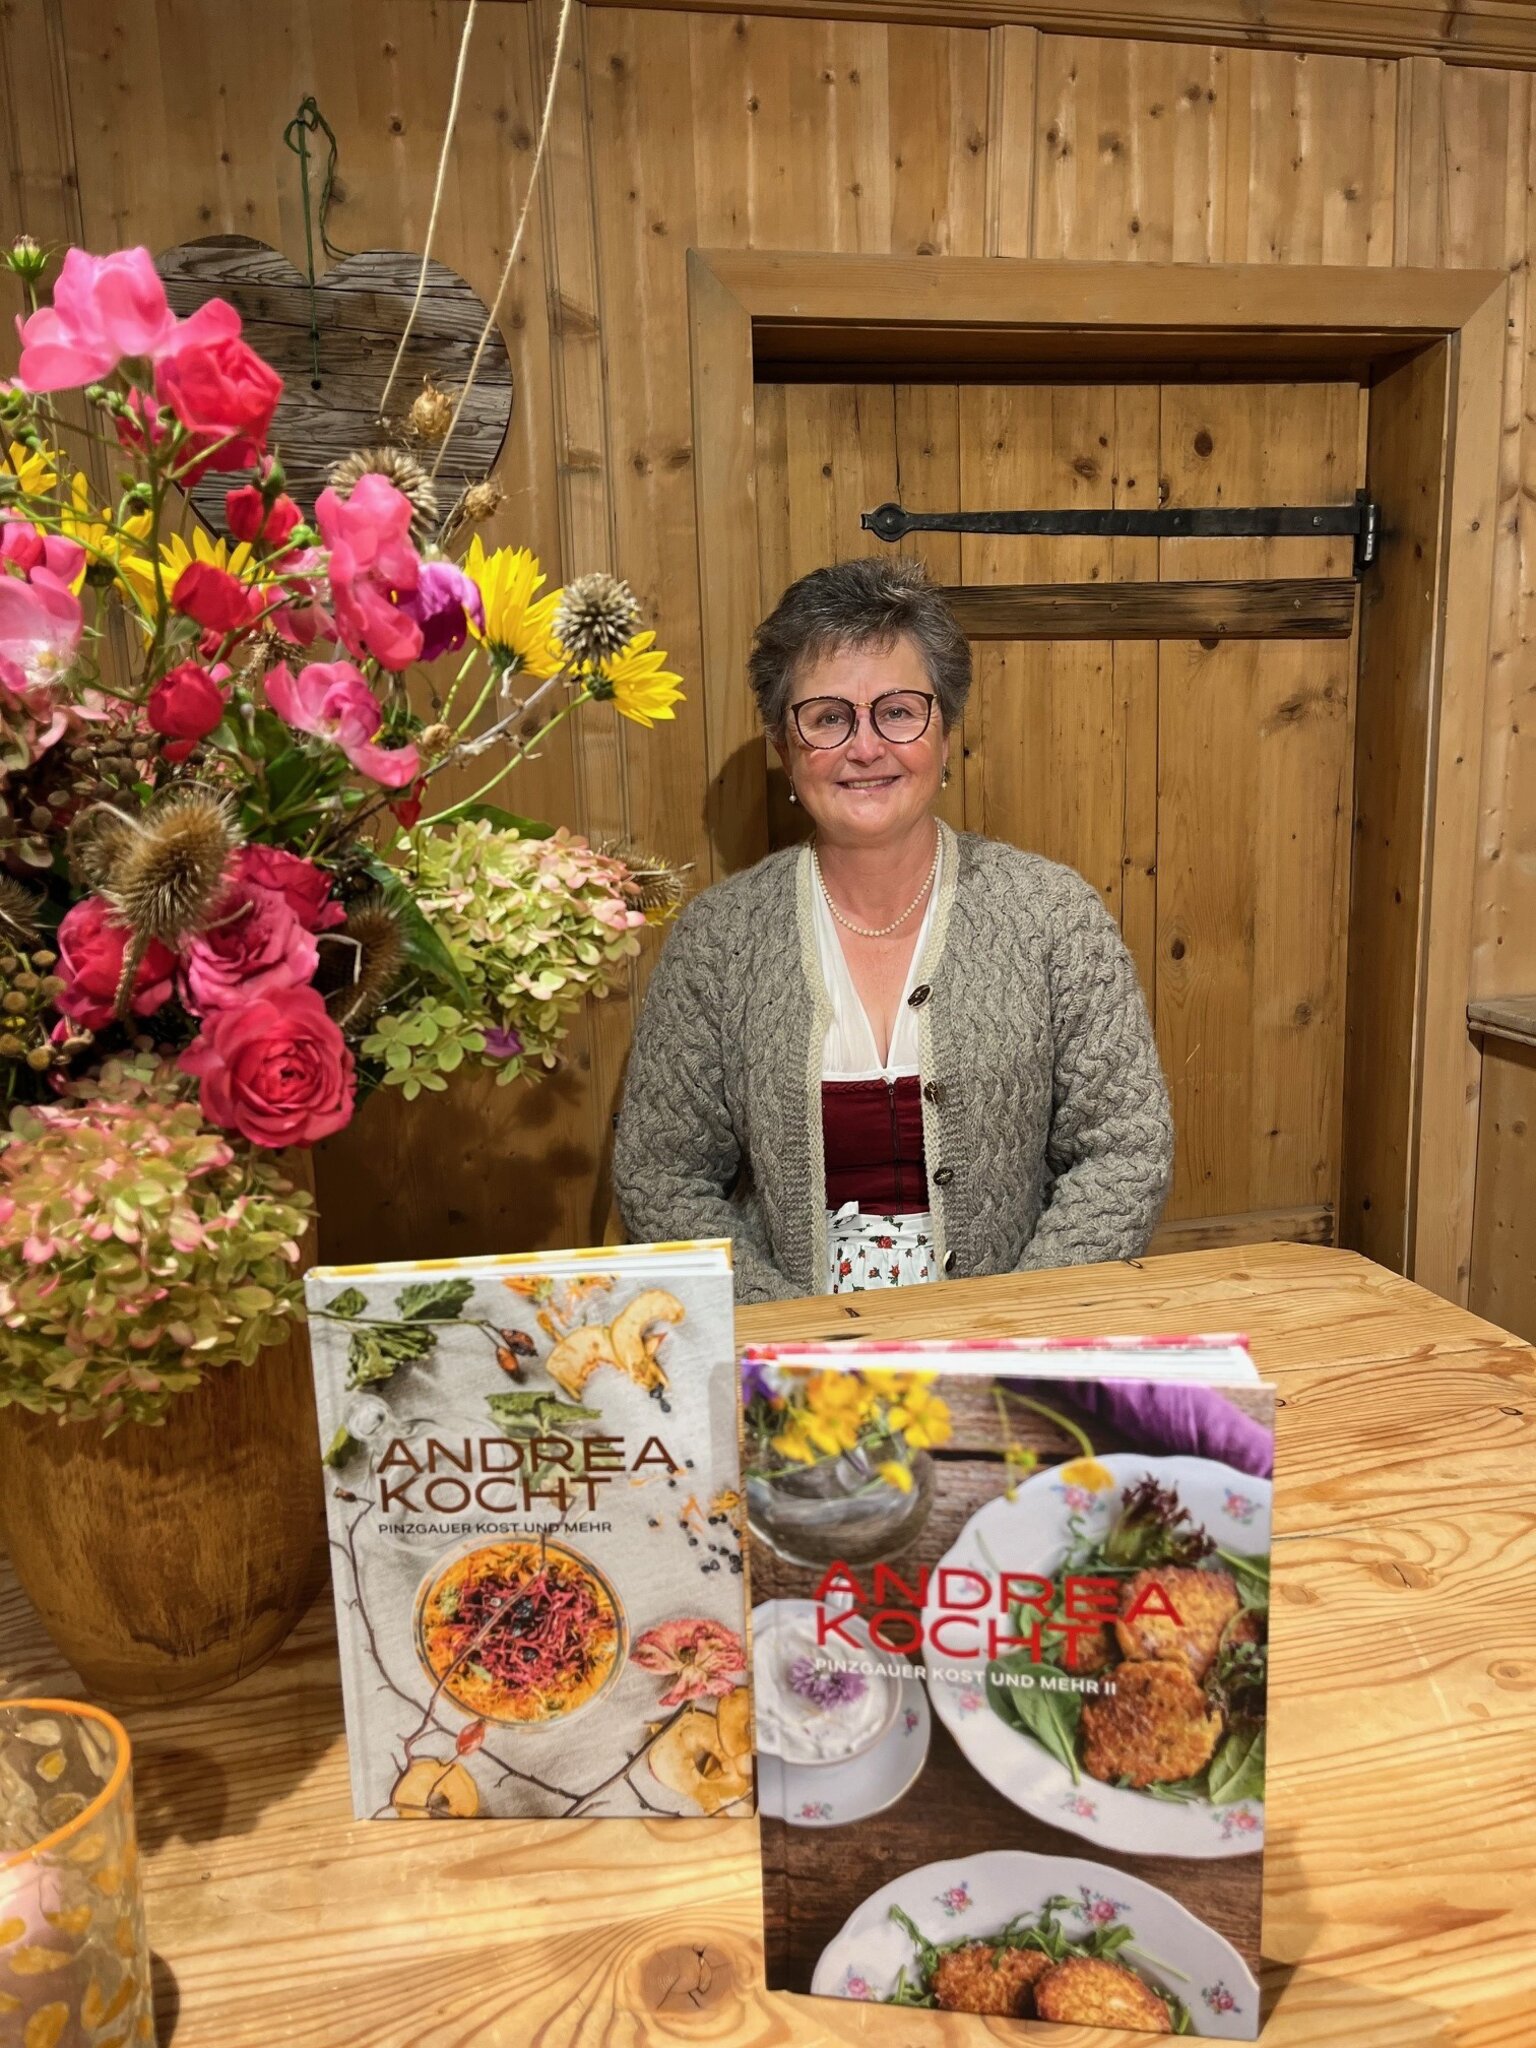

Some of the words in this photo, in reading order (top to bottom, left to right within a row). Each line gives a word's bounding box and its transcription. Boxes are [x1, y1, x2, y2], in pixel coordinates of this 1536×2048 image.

[377, 1436, 680, 1474] ANDREA
[379, 1476, 612, 1514] KOCHT
[378, 1523, 471, 1535] PINZGAUER
[475, 1522, 520, 1534] KOST
[523, 1522, 560, 1534] UND
[564, 1521, 612, 1533] MEHR
[813, 1559, 1184, 1627] ANDREA
[816, 1606, 1100, 1667] KOCHT
[815, 1658, 927, 1680] PINZGAUER
[932, 1668, 985, 1685] KOST
[991, 1674, 1035, 1689] UND
[1040, 1678, 1099, 1694] MEHR
[1104, 1682, 1117, 1696] II
